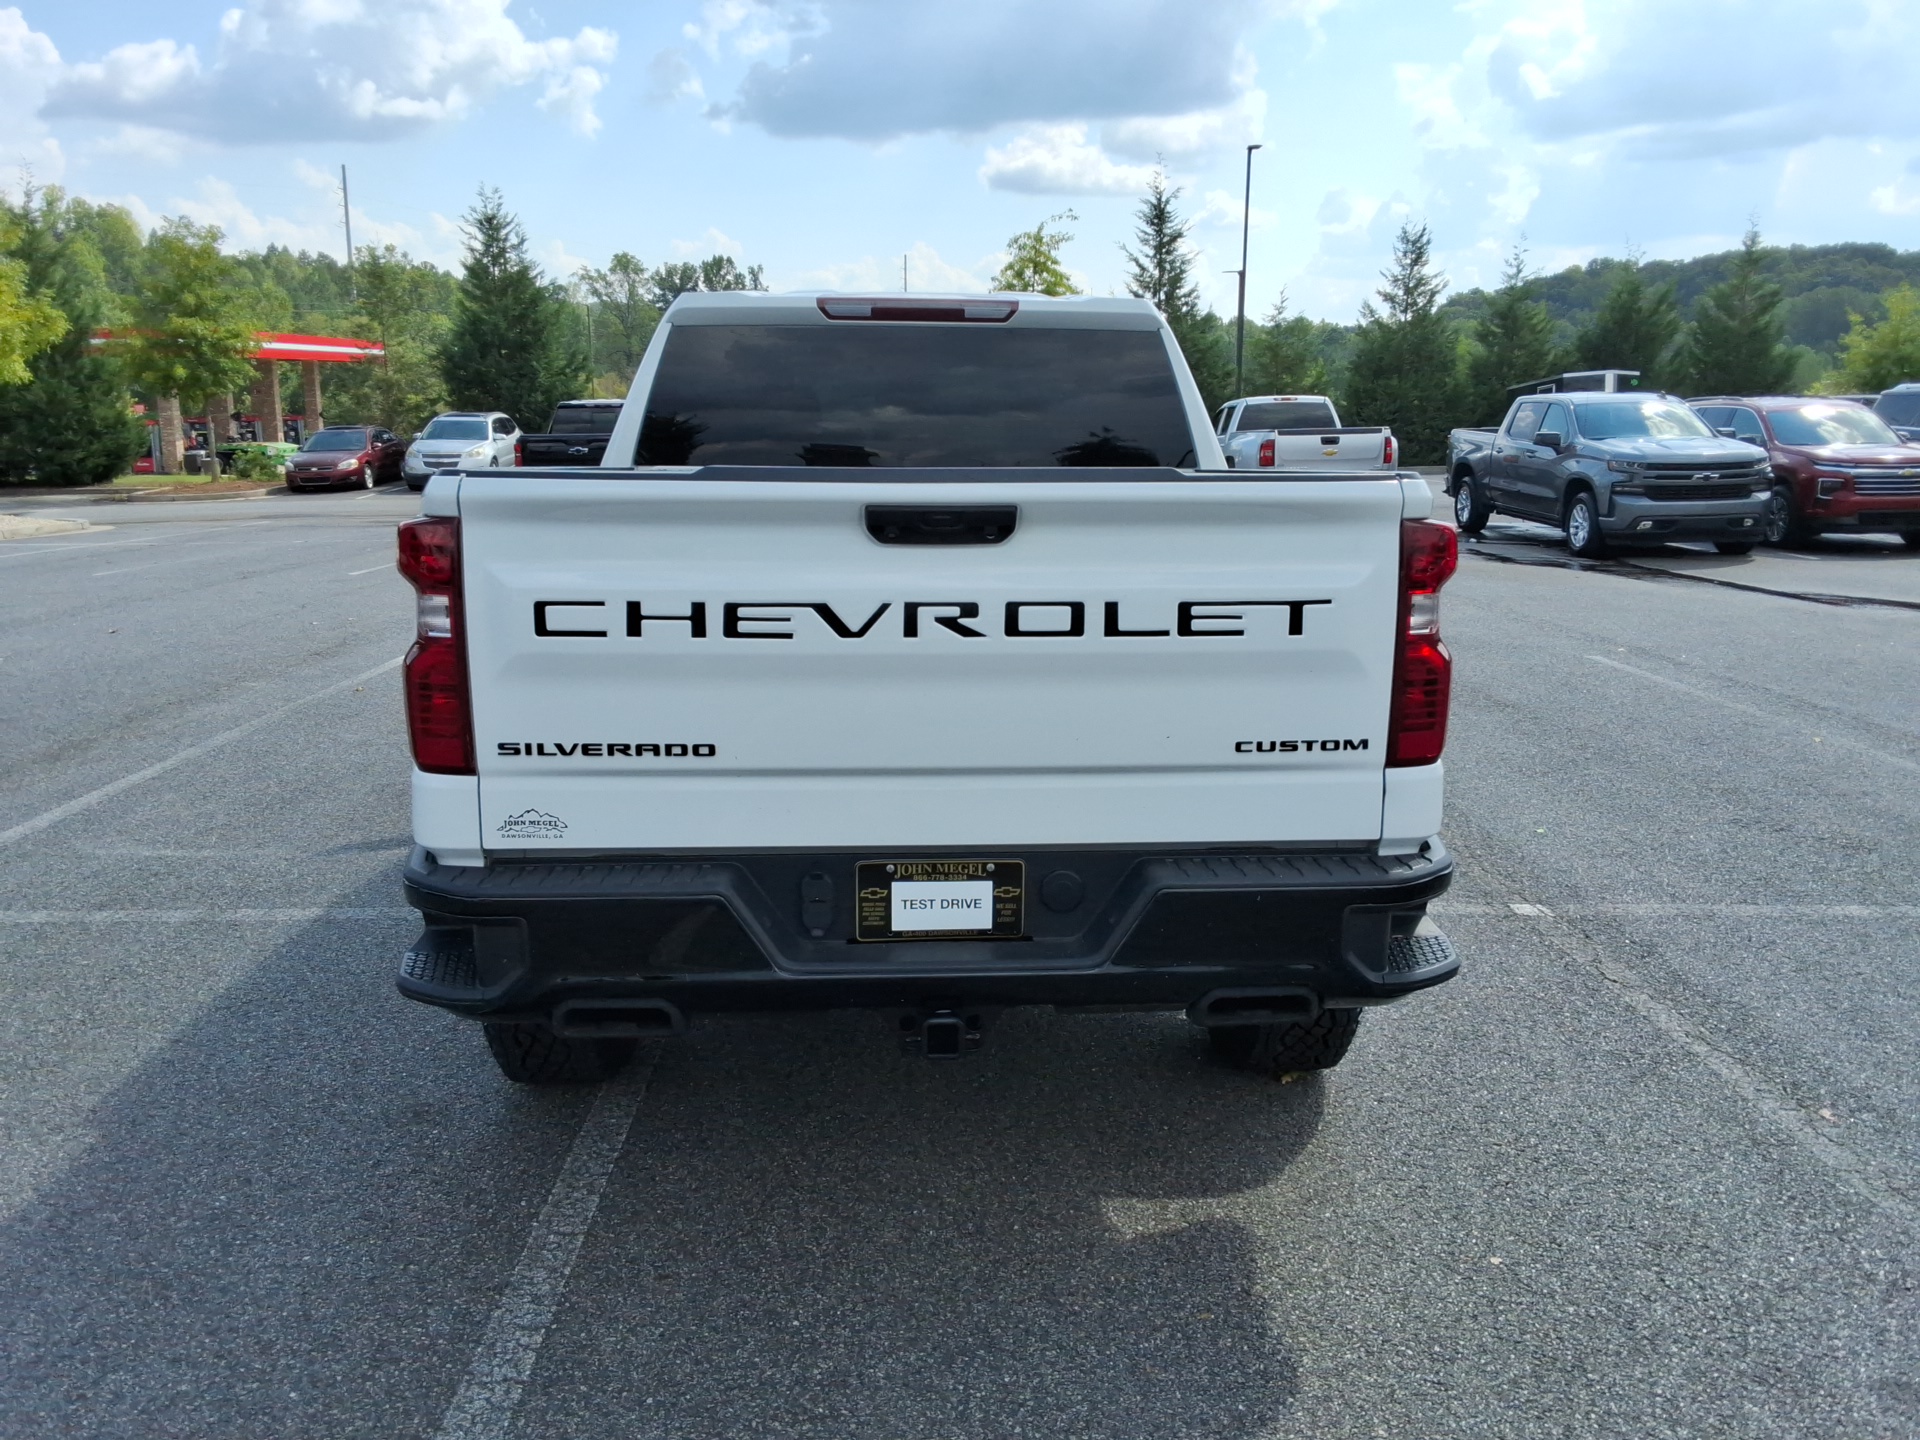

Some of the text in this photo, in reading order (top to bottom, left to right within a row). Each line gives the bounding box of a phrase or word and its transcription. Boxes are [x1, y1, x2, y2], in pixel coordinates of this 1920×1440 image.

[533, 599, 1333, 639] CHEVROLET
[497, 742, 716, 757] SILVERADO
[1234, 739, 1369, 753] CUSTOM
[504, 820, 559, 829] JOHN MEGEL
[894, 863, 987, 879] JOHN MEGEL
[901, 898, 982, 910] TEST DRIVE
